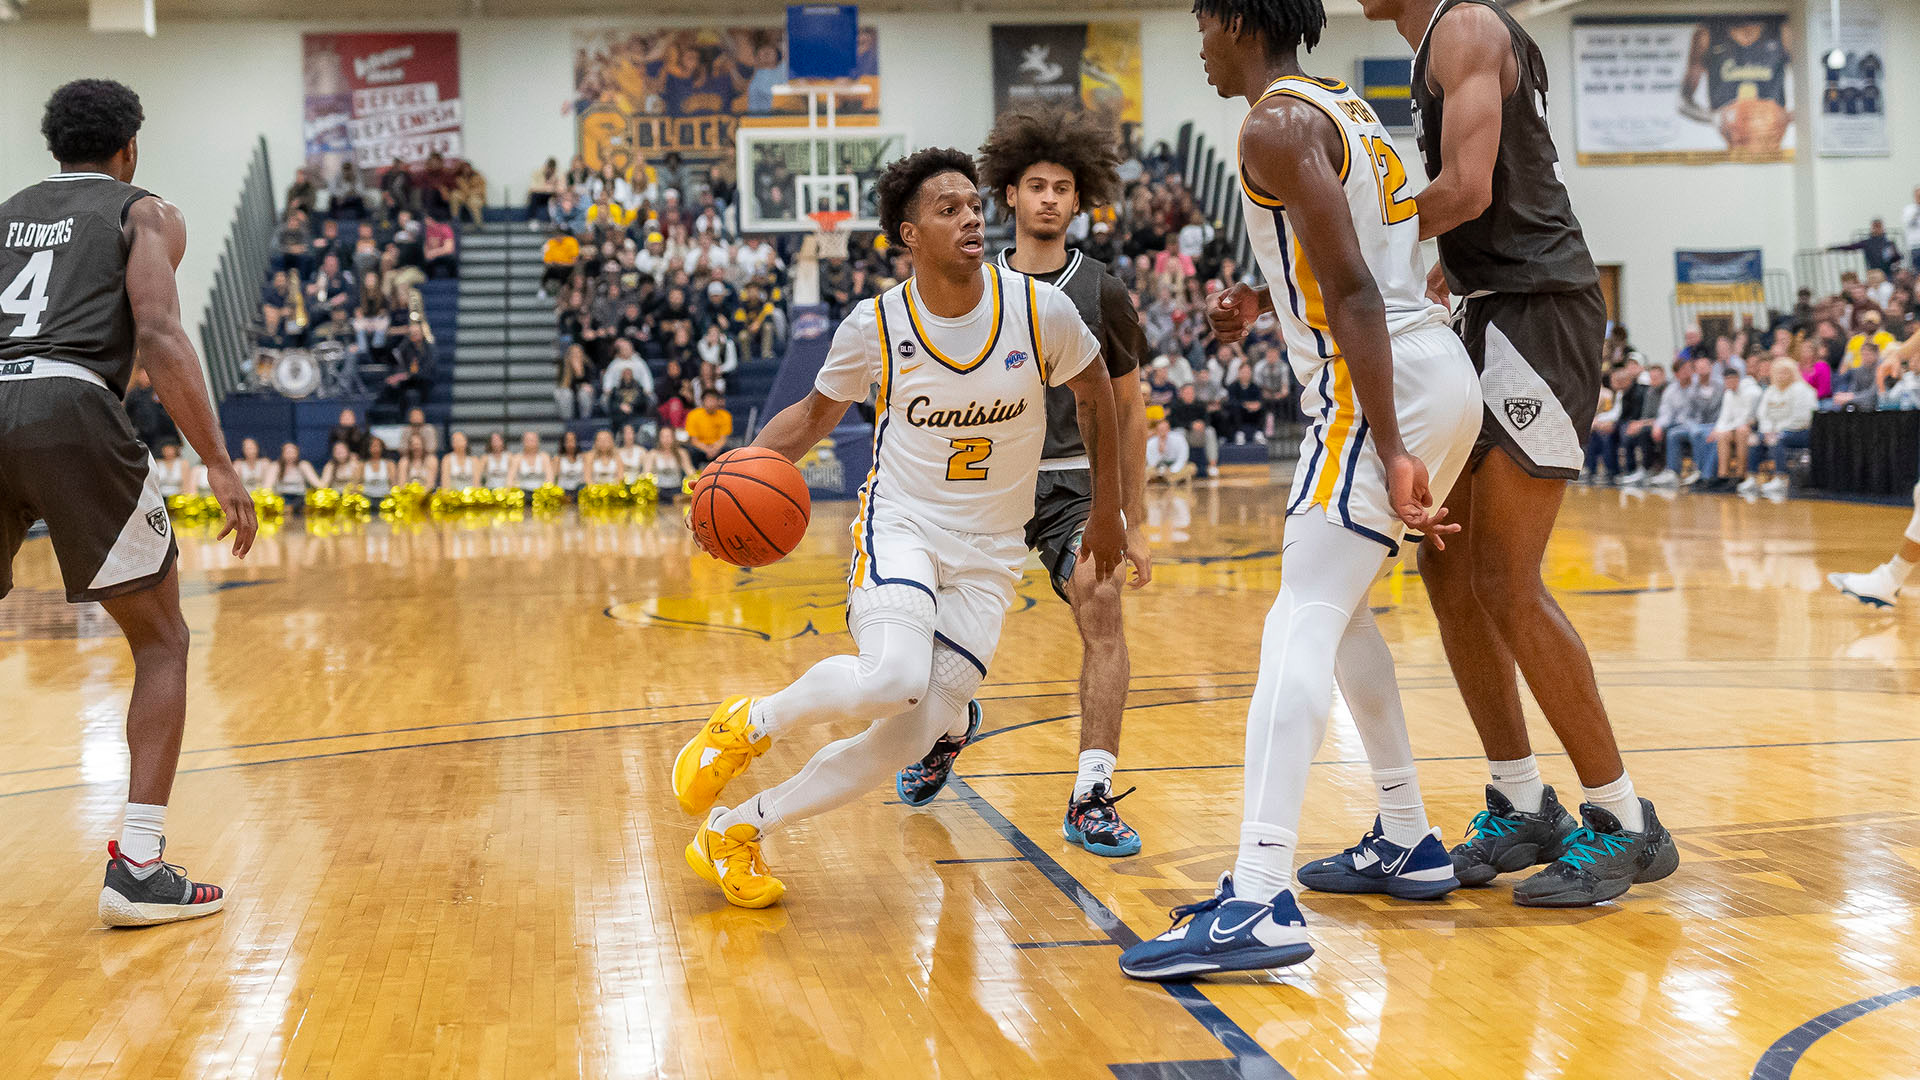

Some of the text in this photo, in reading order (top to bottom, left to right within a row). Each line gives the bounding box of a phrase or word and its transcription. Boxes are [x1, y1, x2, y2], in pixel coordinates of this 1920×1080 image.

[356, 88, 428, 110] REFUEL
[350, 106, 456, 141] REPLENISH
[1359, 134, 1419, 226] 12
[5, 217, 74, 248] FLOWERS
[0, 249, 54, 338] 4
[906, 395, 1028, 428] Canisius
[945, 437, 993, 481] 2
